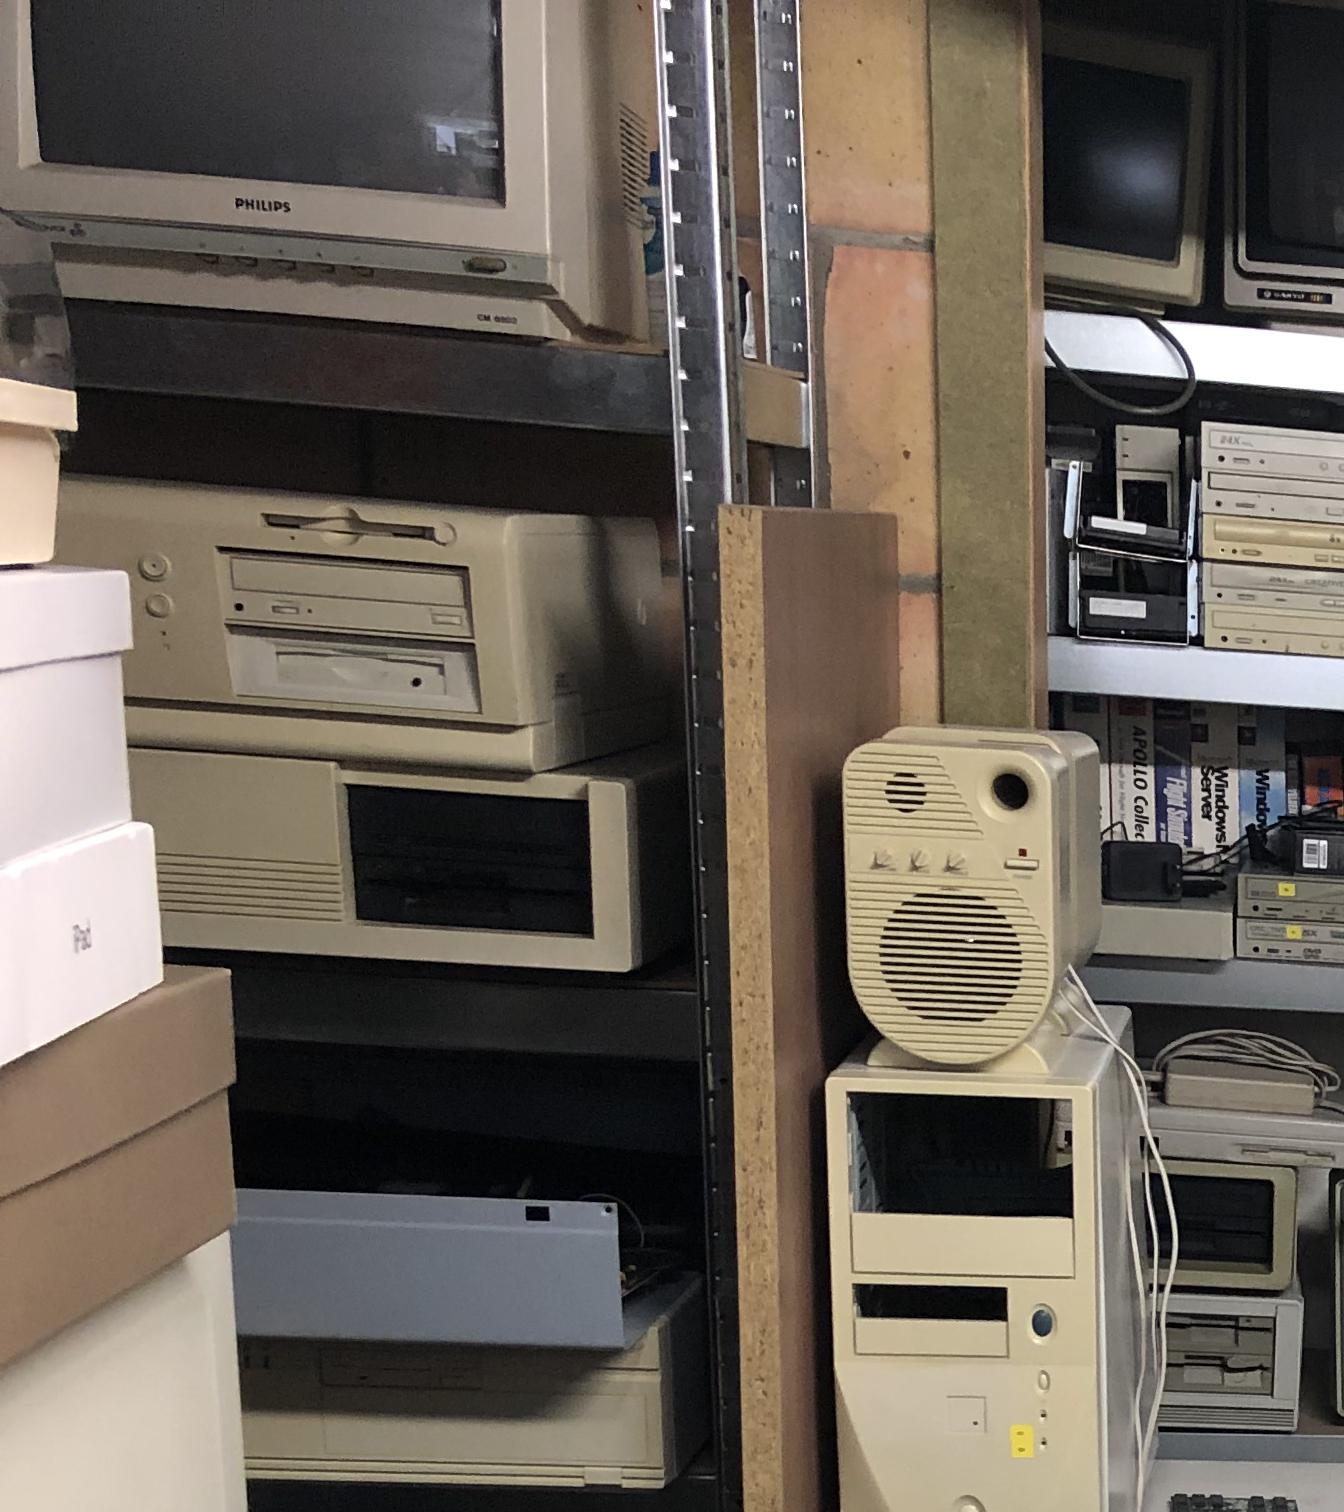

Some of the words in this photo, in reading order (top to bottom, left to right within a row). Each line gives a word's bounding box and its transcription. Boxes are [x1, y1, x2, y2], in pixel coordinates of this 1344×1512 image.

[235, 197, 291, 213] PHILIPS
[1132, 725, 1148, 790] APOLLO
[1201, 764, 1215, 821] Server
[1214, 765, 1230, 845] Windows
[1133, 796, 1150, 841] Collec
[73, 918, 92, 954] iPad
